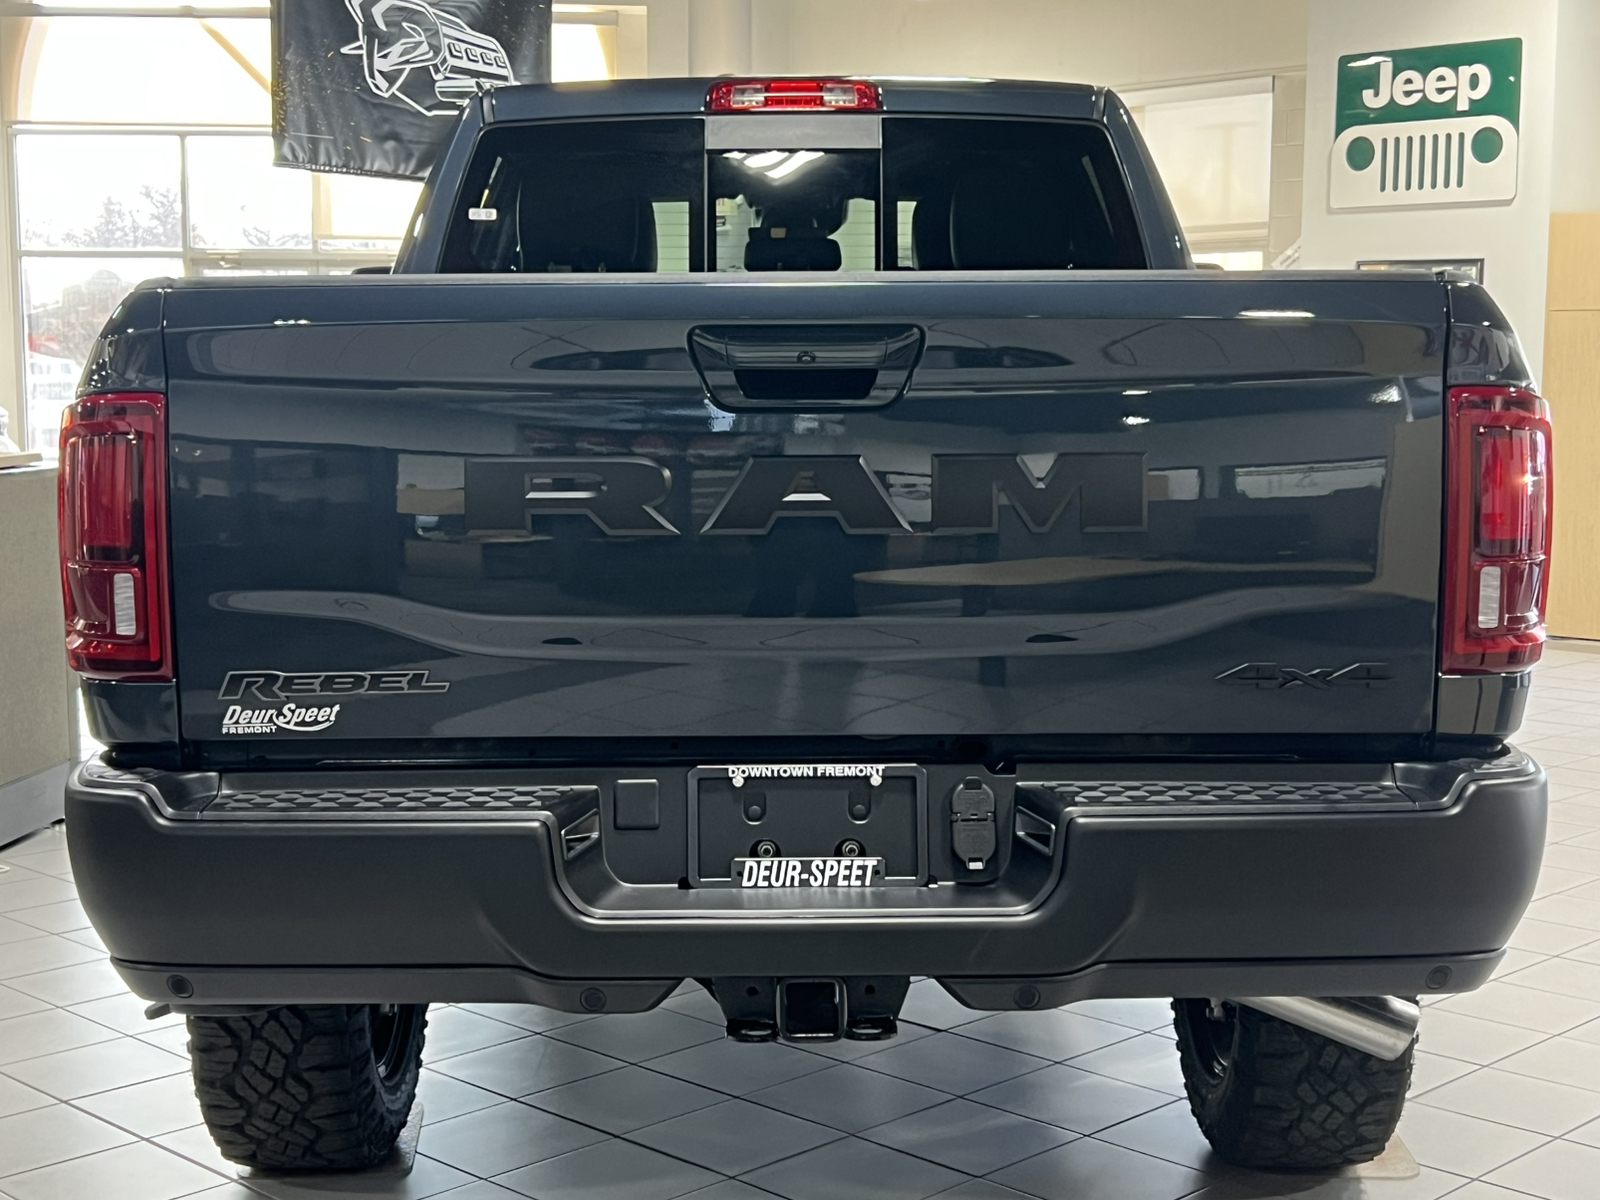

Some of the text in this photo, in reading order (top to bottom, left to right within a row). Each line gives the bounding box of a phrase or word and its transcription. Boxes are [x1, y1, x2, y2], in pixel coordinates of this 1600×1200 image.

[1362, 61, 1491, 111] Jeep
[465, 453, 1148, 536] RAM
[217, 670, 450, 701] REBEL
[222, 703, 340, 729] Deur Speet
[222, 726, 277, 734] FREMONT
[728, 765, 885, 778] DOWNTOWN FREMONT
[741, 859, 878, 887] DEUR-SPEET
